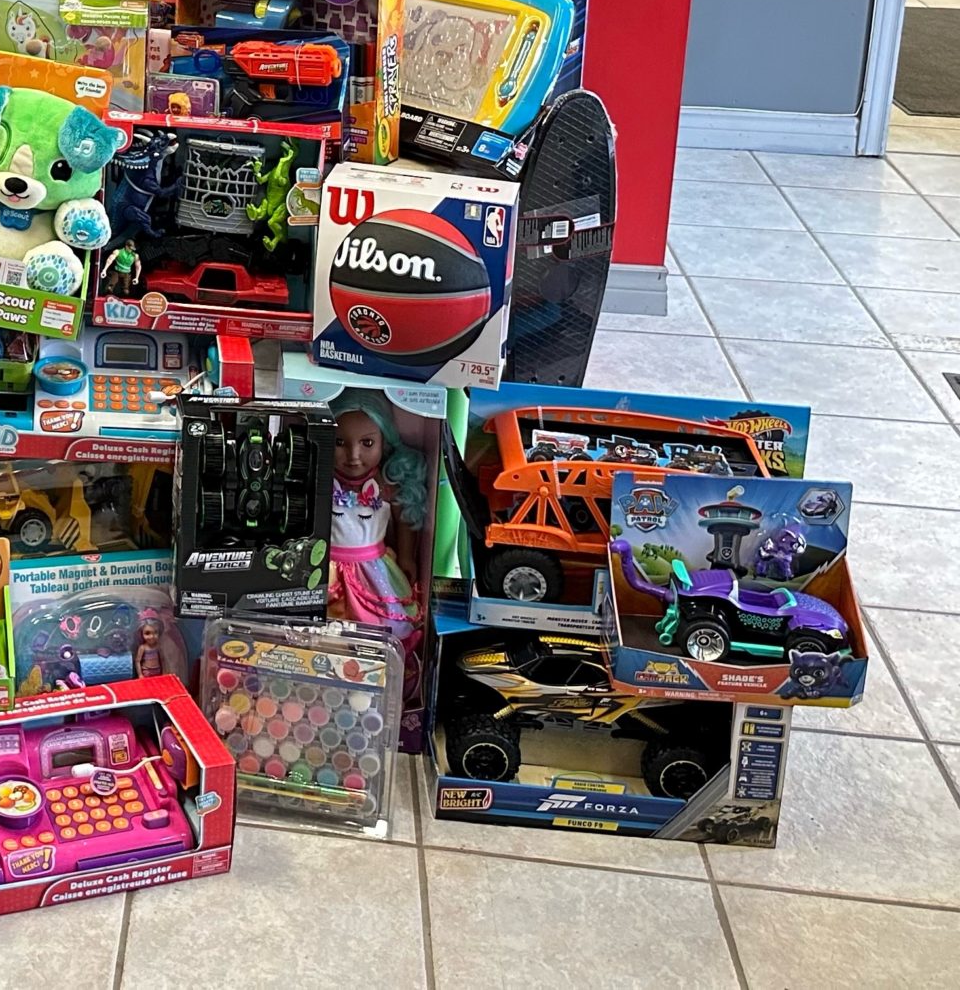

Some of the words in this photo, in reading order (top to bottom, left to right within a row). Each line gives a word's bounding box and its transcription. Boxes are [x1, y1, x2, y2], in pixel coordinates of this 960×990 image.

[320, 340, 335, 350] NBA
[320, 348, 364, 364] BASKETBALL
[92, 444, 124, 452] Deluxe
[629, 515, 664, 524] PATROL
[186, 551, 253, 566] ADVENTURE
[205, 560, 250, 571] FORCE
[13, 569, 55, 582] Portable
[59, 568, 96, 579] Magnet
[100, 568, 107, 576] &
[111, 563, 152, 576] Drawing
[722, 674, 764, 682] SHADE'S
[444, 790, 466, 799] NEW
[443, 799, 482, 807] BRIGHT
[585, 803, 639, 815] FORZA
[70, 878, 104, 890] Deluxe
[106, 874, 130, 884] Cash
[132, 865, 171, 879] Register
[52, 890, 83, 902] Caisse
[85, 878, 147, 897] enregistreuse
[149, 874, 161, 883] de
[162, 869, 187, 882] luxe
